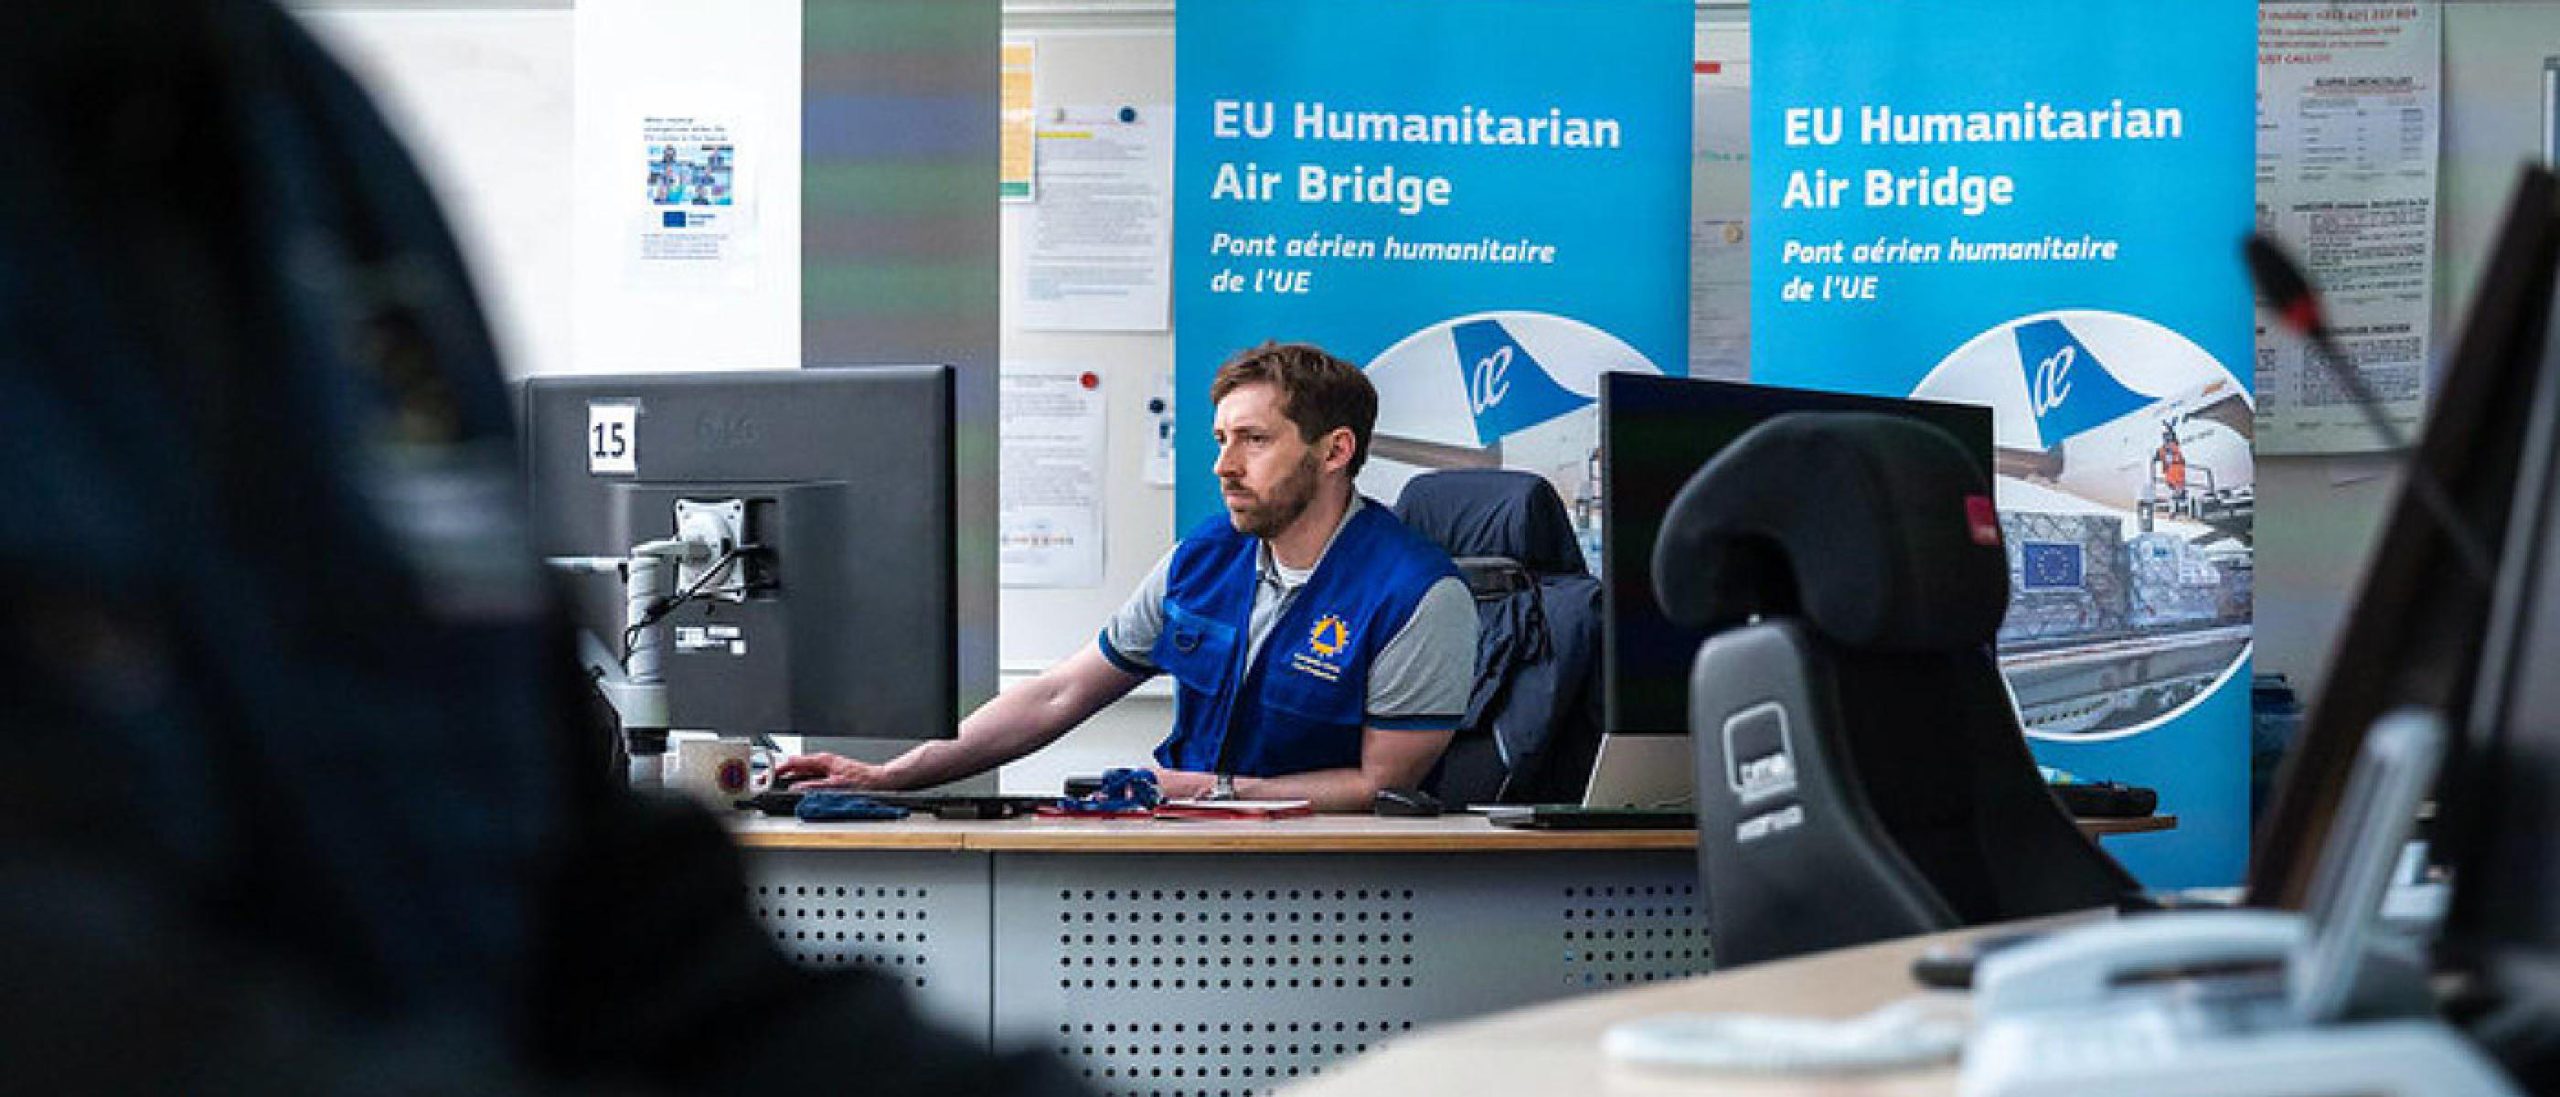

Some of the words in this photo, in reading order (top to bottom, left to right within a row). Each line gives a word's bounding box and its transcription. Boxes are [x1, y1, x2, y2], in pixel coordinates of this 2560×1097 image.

[1213, 100, 1274, 139] EU
[1294, 102, 1621, 148] Humanitarian
[1784, 106, 1843, 146] EU
[1861, 98, 2183, 144] Humanitarian
[1211, 162, 1282, 201] Air
[1298, 165, 1453, 215] Bridge
[1782, 168, 1850, 210] Air
[1864, 165, 2015, 217] Bridge
[1211, 233, 1277, 257] Pont
[1285, 231, 1376, 259] aérien
[1383, 235, 1557, 264] humanitaire
[1782, 240, 1845, 264] Pont
[1851, 236, 1941, 263] aérien
[1947, 235, 2119, 261] humanitaire
[1210, 268, 1245, 293] de
[1781, 275, 1815, 301] de
[593, 422, 626, 458] 15
